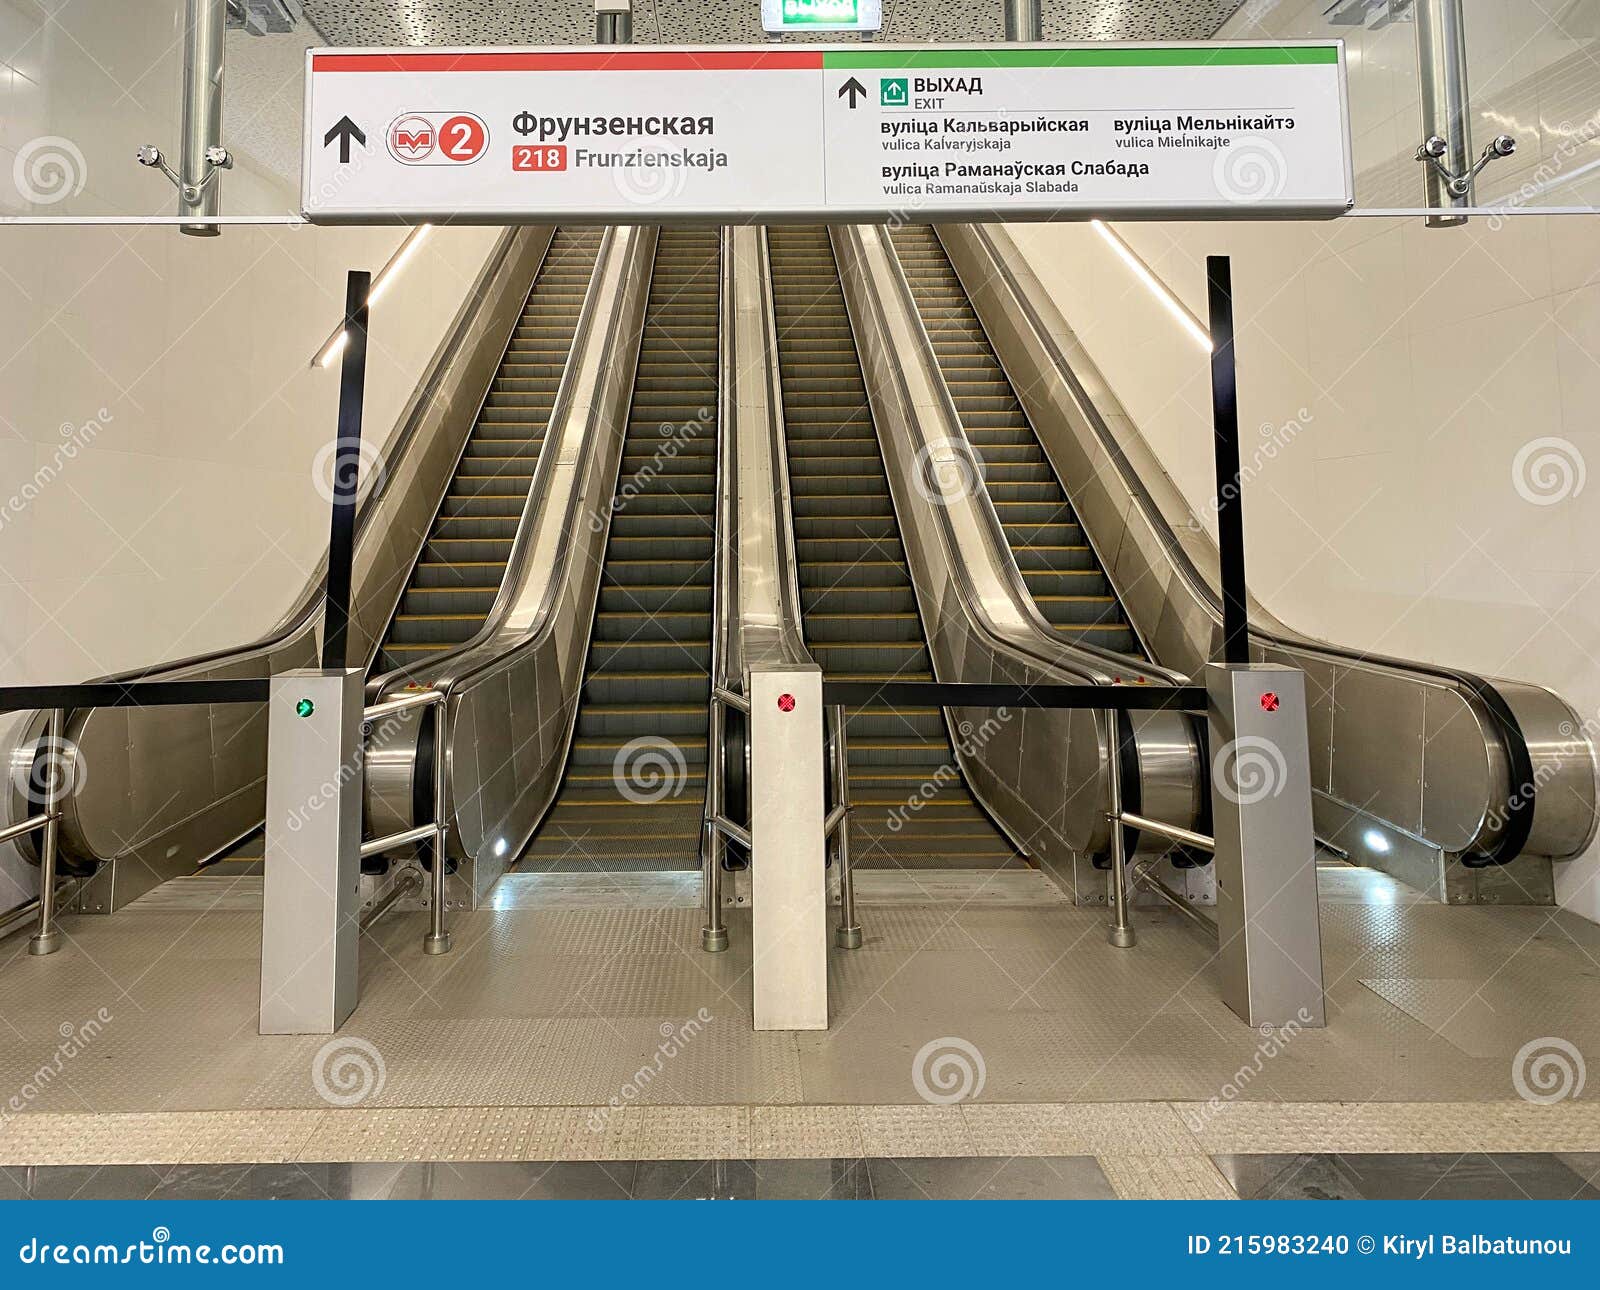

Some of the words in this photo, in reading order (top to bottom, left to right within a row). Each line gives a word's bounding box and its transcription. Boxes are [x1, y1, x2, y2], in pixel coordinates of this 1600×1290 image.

[914, 77, 983, 96] ВЫХАД
[914, 98, 945, 110] EXIT
[512, 110, 715, 141] Фрунзенская
[880, 118, 938, 137] вуліца
[943, 116, 1090, 136] Кальварыйская
[1113, 116, 1172, 134] вуліца
[1177, 114, 1296, 131] Мельнікайтэ
[450, 123, 473, 155] 2
[881, 139, 921, 151] vulica
[1115, 136, 1155, 148] vulica
[518, 148, 560, 168] 218
[575, 147, 729, 172] Frunzienskaja
[881, 162, 940, 181] вуліца
[944, 161, 1067, 180] Раманаўская
[1070, 160, 1150, 178] Слабада
[882, 182, 922, 195] vulica
[1025, 180, 1080, 193] Slabada
